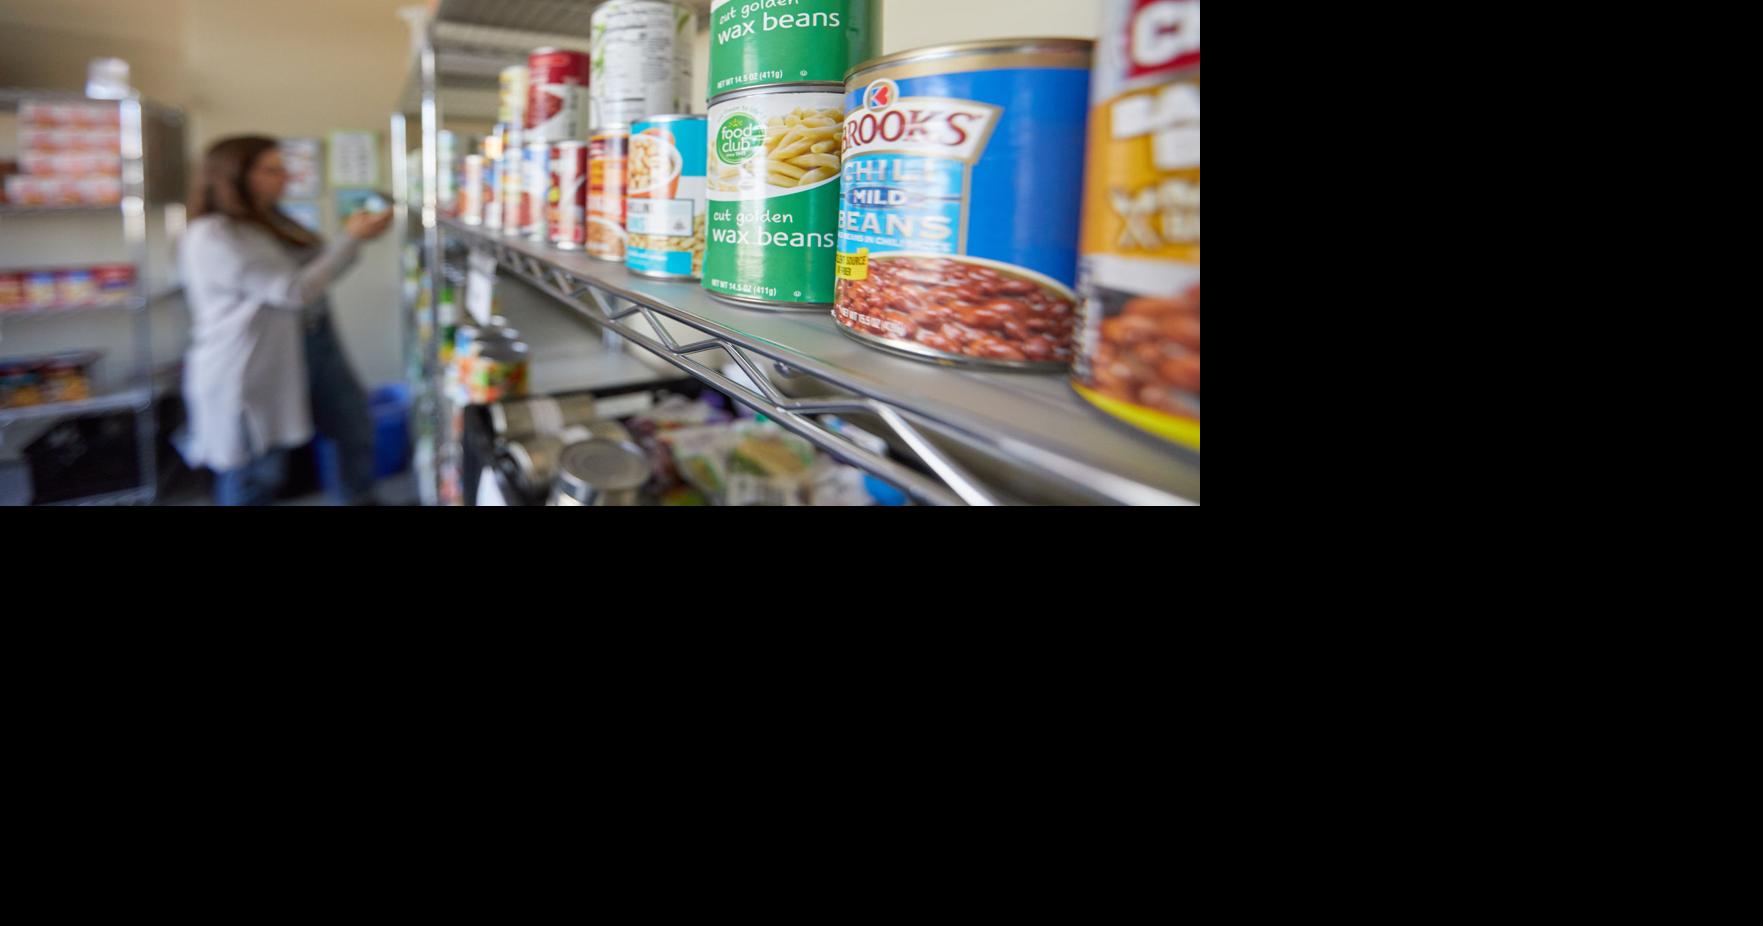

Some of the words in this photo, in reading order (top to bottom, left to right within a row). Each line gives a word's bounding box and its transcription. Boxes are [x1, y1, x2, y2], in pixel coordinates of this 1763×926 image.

[719, 7, 736, 25] cut
[718, 20, 755, 45] wax
[763, 12, 840, 31] beans
[717, 79, 726, 89] NET
[726, 77, 734, 87] WT
[735, 74, 748, 84] 14.5
[748, 72, 758, 81] OZ
[759, 70, 783, 81] (411g)
[722, 123, 752, 140] food
[722, 138, 751, 153] club
[852, 189, 907, 205] MILD
[713, 209, 731, 221] cut
[736, 209, 793, 226] golden
[838, 209, 952, 240] BEANS
[712, 228, 750, 245] wax
[757, 226, 834, 248] beans
[711, 278, 720, 287] NET
[720, 280, 728, 288] WT
[729, 282, 742, 291] 14.5
[743, 284, 753, 292] OZ
[753, 286, 777, 297] (411g)
